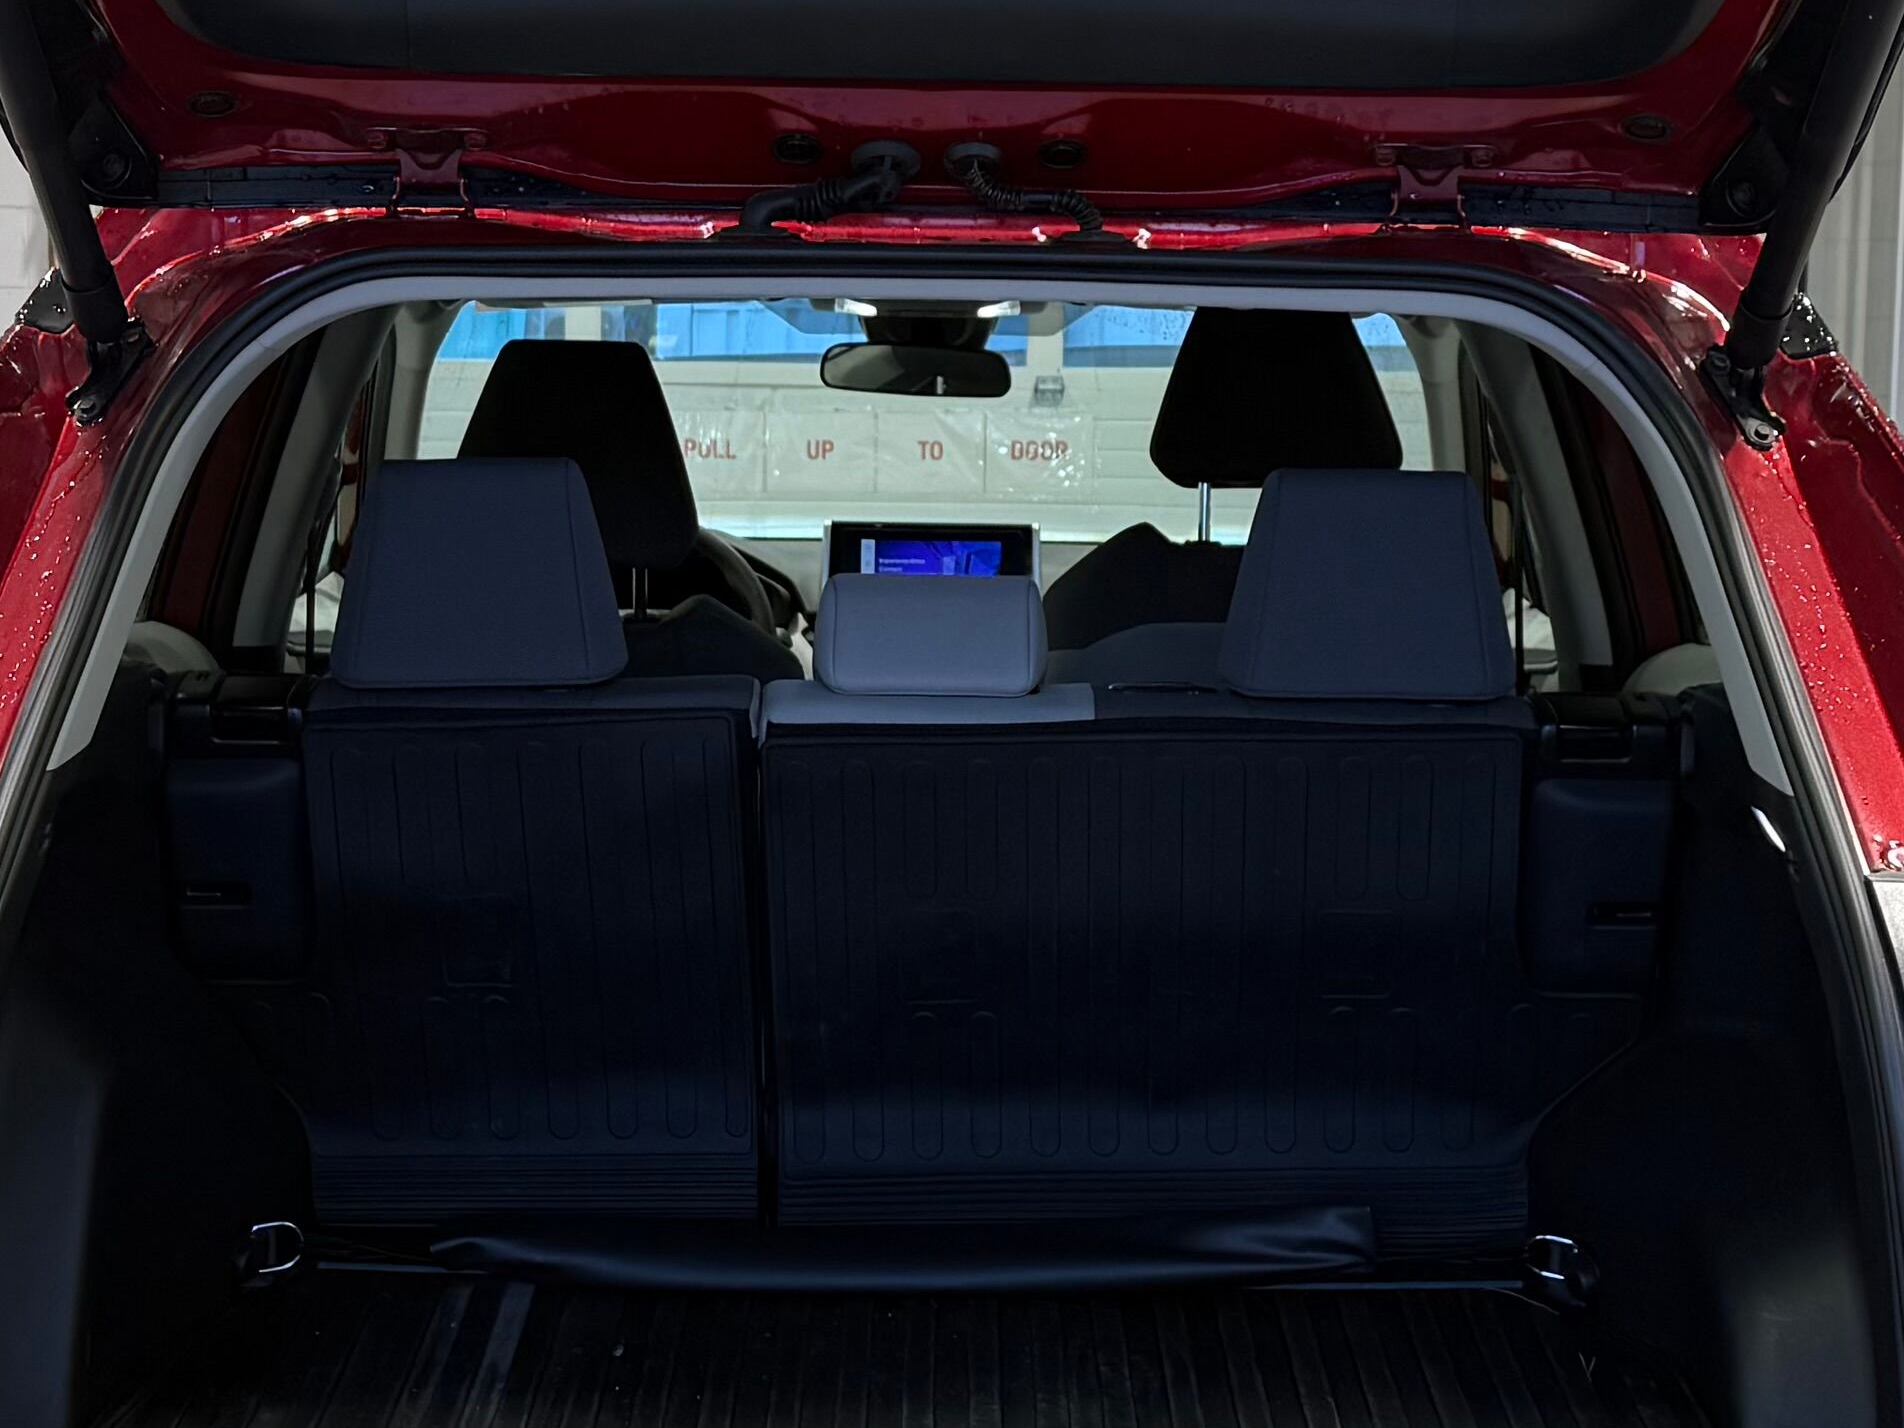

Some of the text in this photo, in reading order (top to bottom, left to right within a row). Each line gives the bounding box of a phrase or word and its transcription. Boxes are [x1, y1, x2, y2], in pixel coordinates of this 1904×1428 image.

[684, 439, 1070, 461] PULL UP TO DOOR
